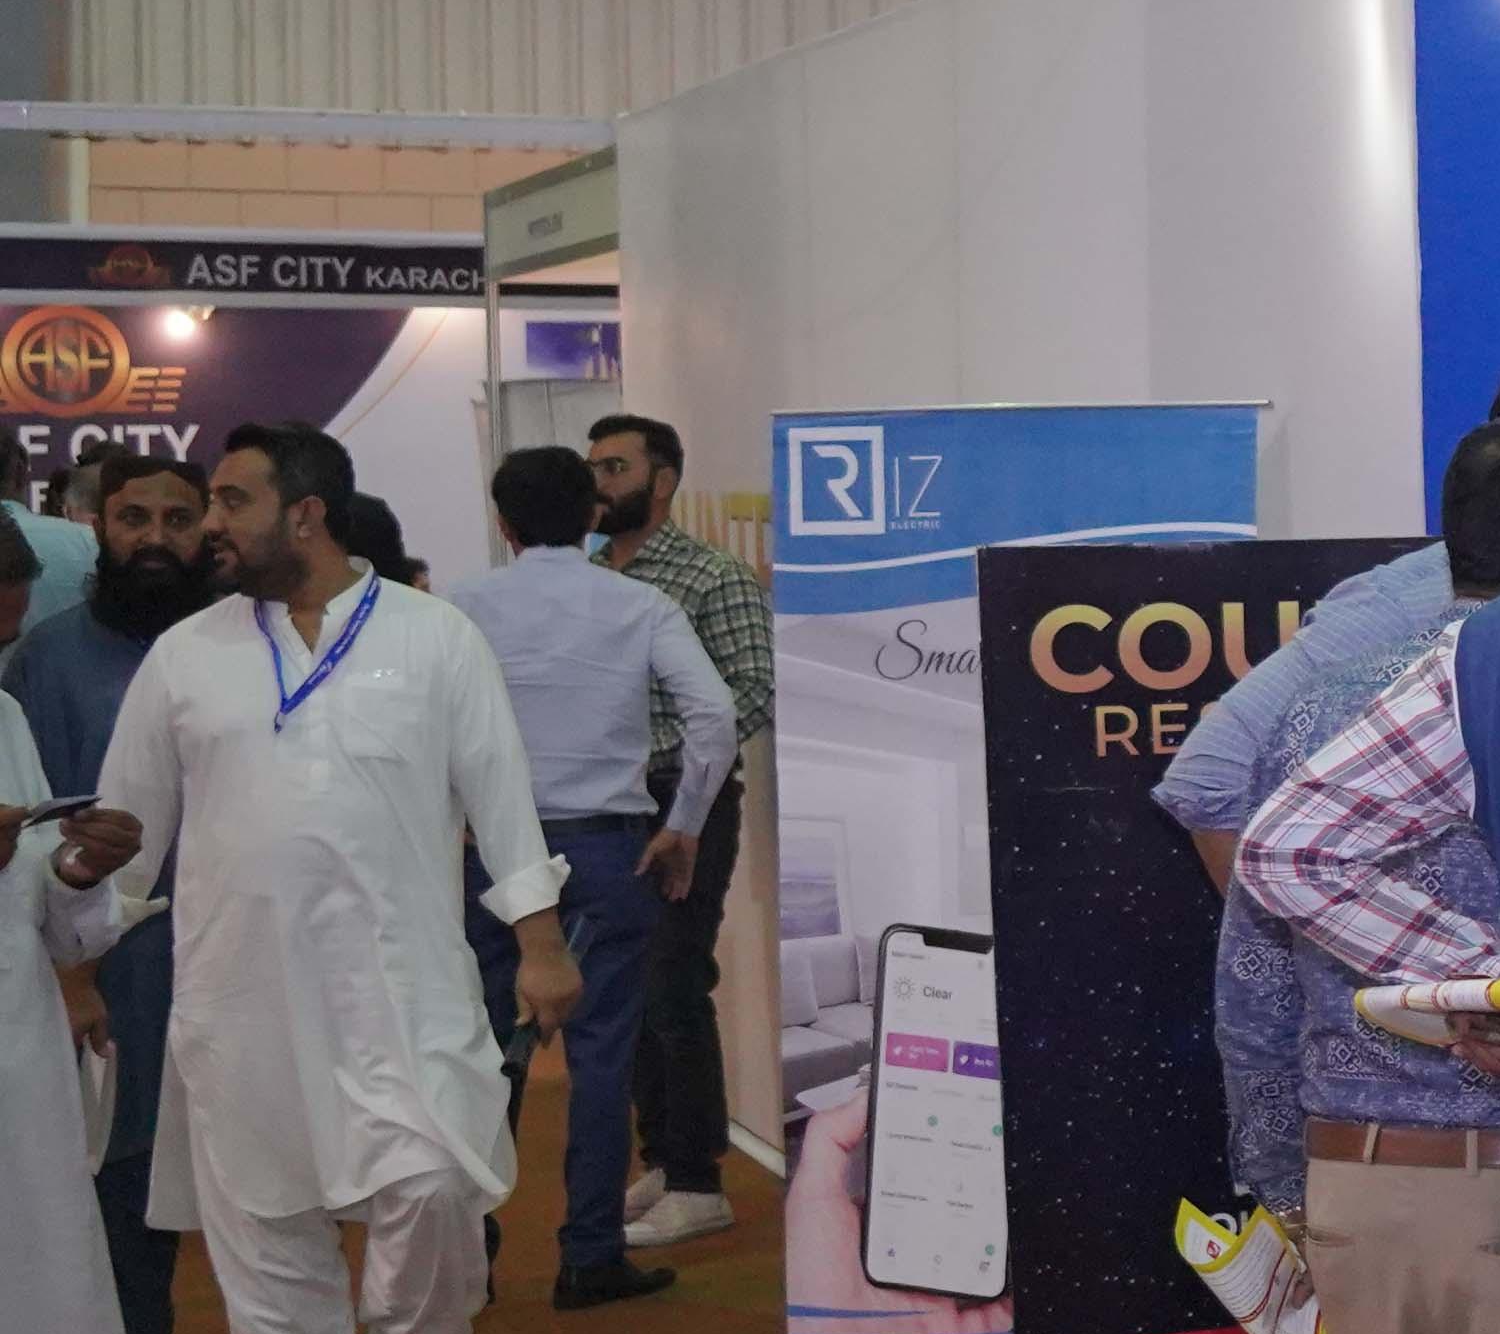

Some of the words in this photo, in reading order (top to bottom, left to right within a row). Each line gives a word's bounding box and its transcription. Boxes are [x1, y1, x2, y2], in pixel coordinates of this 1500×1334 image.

[188, 253, 263, 286] ASF
[272, 255, 355, 288] CITY
[890, 520, 942, 531] ELECTRIC
[875, 619, 978, 680] Sma
[1095, 702, 1217, 758] RE
[923, 986, 953, 1000] Clear
